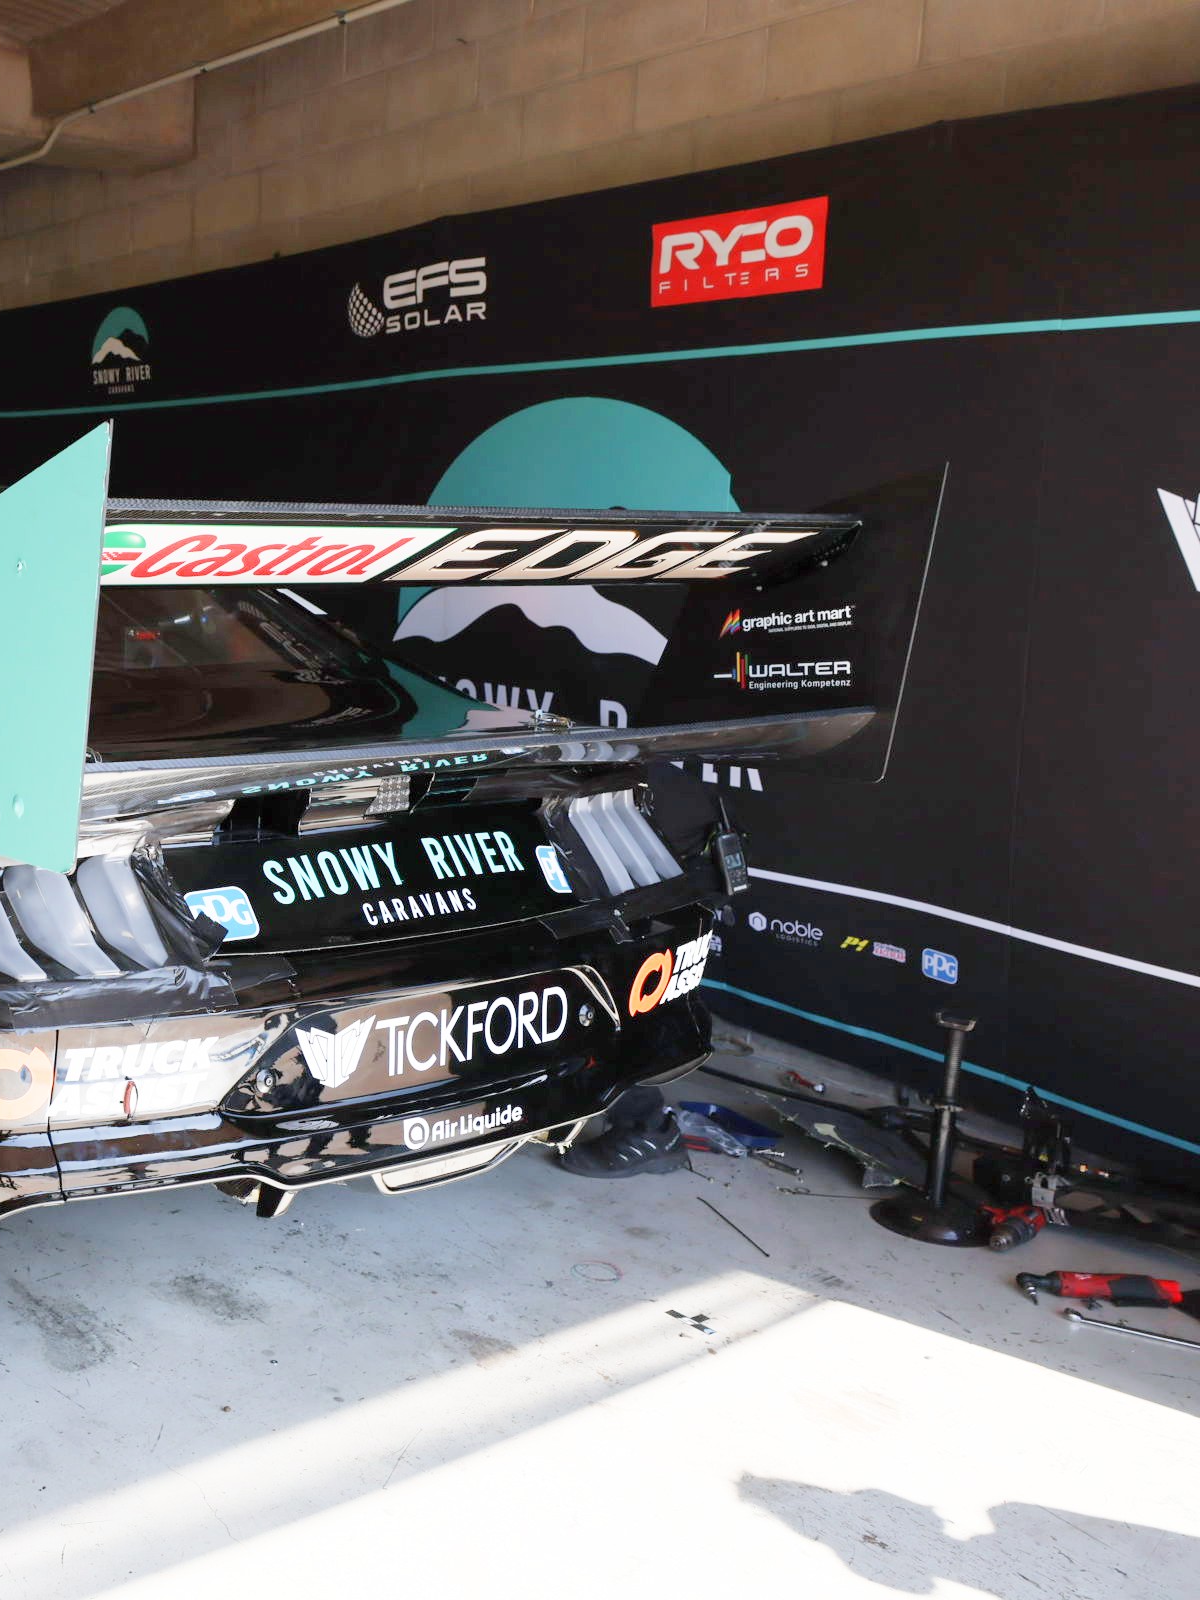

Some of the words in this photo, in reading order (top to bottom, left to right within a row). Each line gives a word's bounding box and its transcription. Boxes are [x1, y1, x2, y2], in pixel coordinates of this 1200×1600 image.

[658, 214, 814, 274] RYCO
[383, 257, 487, 310] EFS
[658, 263, 810, 295] FILTERS
[386, 302, 487, 334] SOLAR
[92, 367, 120, 385] SNOWY
[125, 364, 151, 382] RIVER
[130, 533, 416, 578] Castrol
[383, 528, 820, 581] EDGE
[742, 611, 793, 632] graphic
[794, 609, 815, 624] art
[817, 605, 852, 621] mart
[749, 661, 851, 678] WALTER
[749, 680, 799, 691] Engineering
[801, 679, 851, 689] Kompetenz
[263, 841, 403, 905] SNOWY
[421, 830, 525, 880] RIVER
[362, 887, 478, 927] CARAVANS
[770, 918, 824, 941] noble
[924, 952, 957, 979] PPG
[375, 986, 568, 1077] TICKFORD
[64, 1036, 220, 1082] TRUCK
[432, 1119, 458, 1142] Air
[460, 1104, 523, 1135] Liquide
